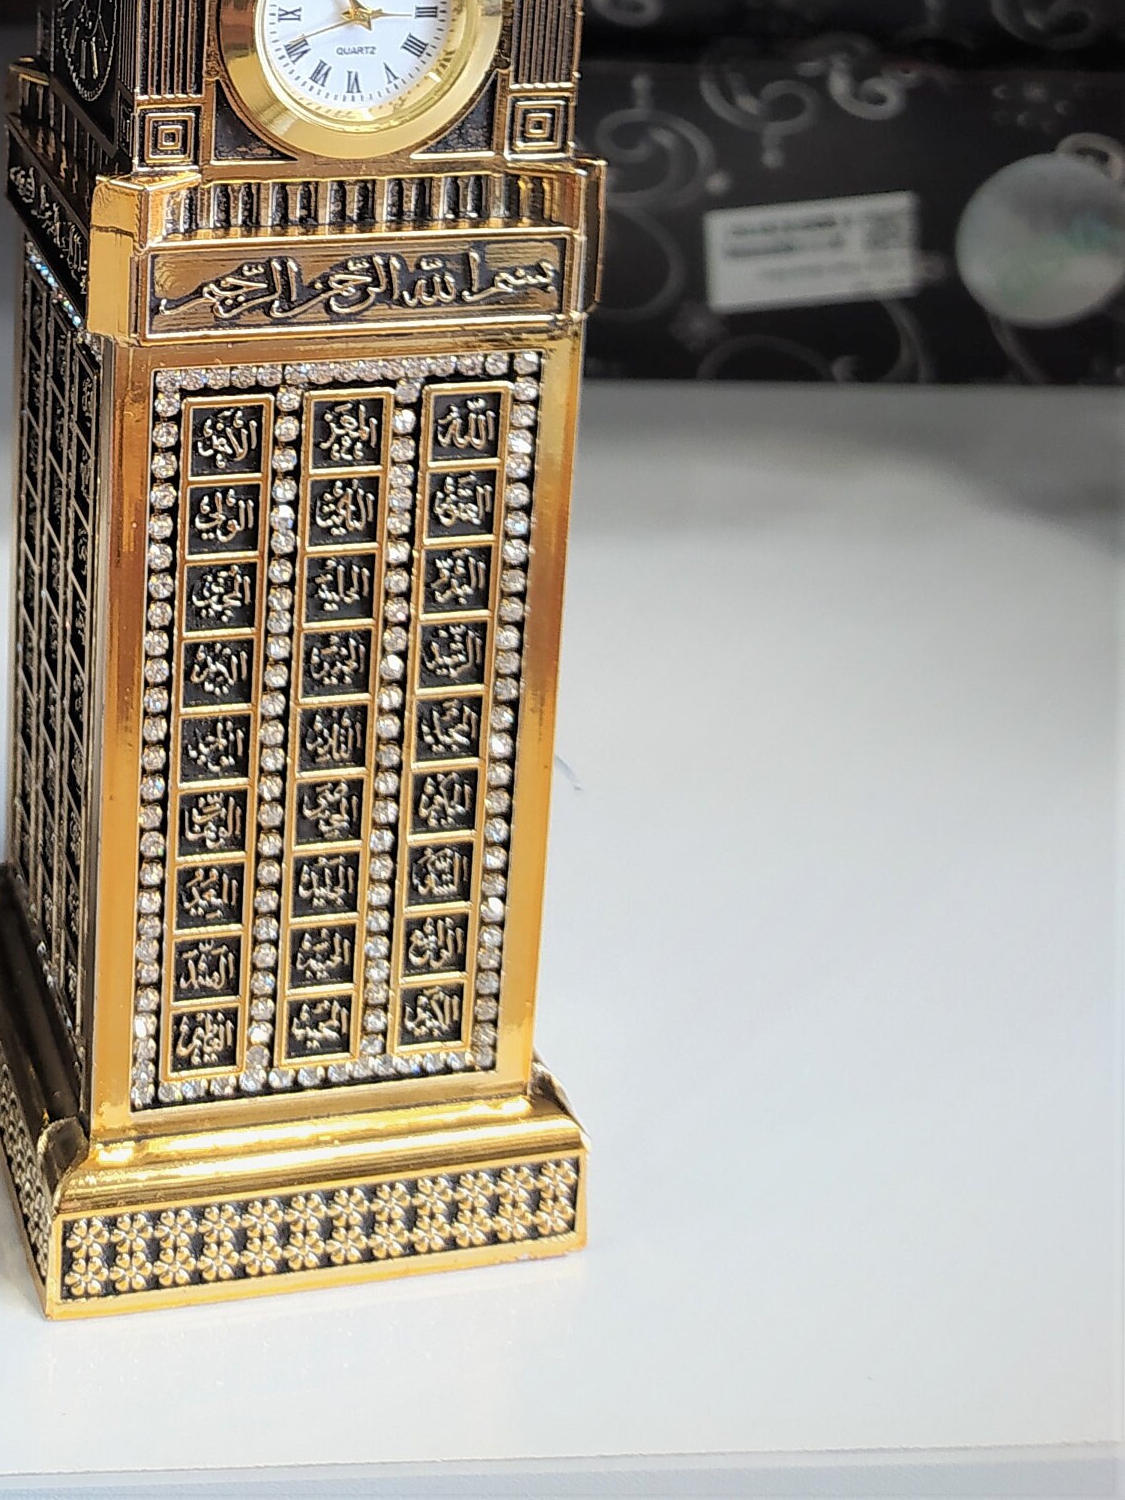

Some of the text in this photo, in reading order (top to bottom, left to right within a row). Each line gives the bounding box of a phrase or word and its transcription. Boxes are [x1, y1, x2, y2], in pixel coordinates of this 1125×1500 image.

[277, 6, 302, 23] IX
[414, 6, 438, 19] III
[335, 46, 377, 55] QUARTZ
[308, 59, 333, 87] VII
[346, 70, 361, 94] VI
[382, 61, 400, 84] V
